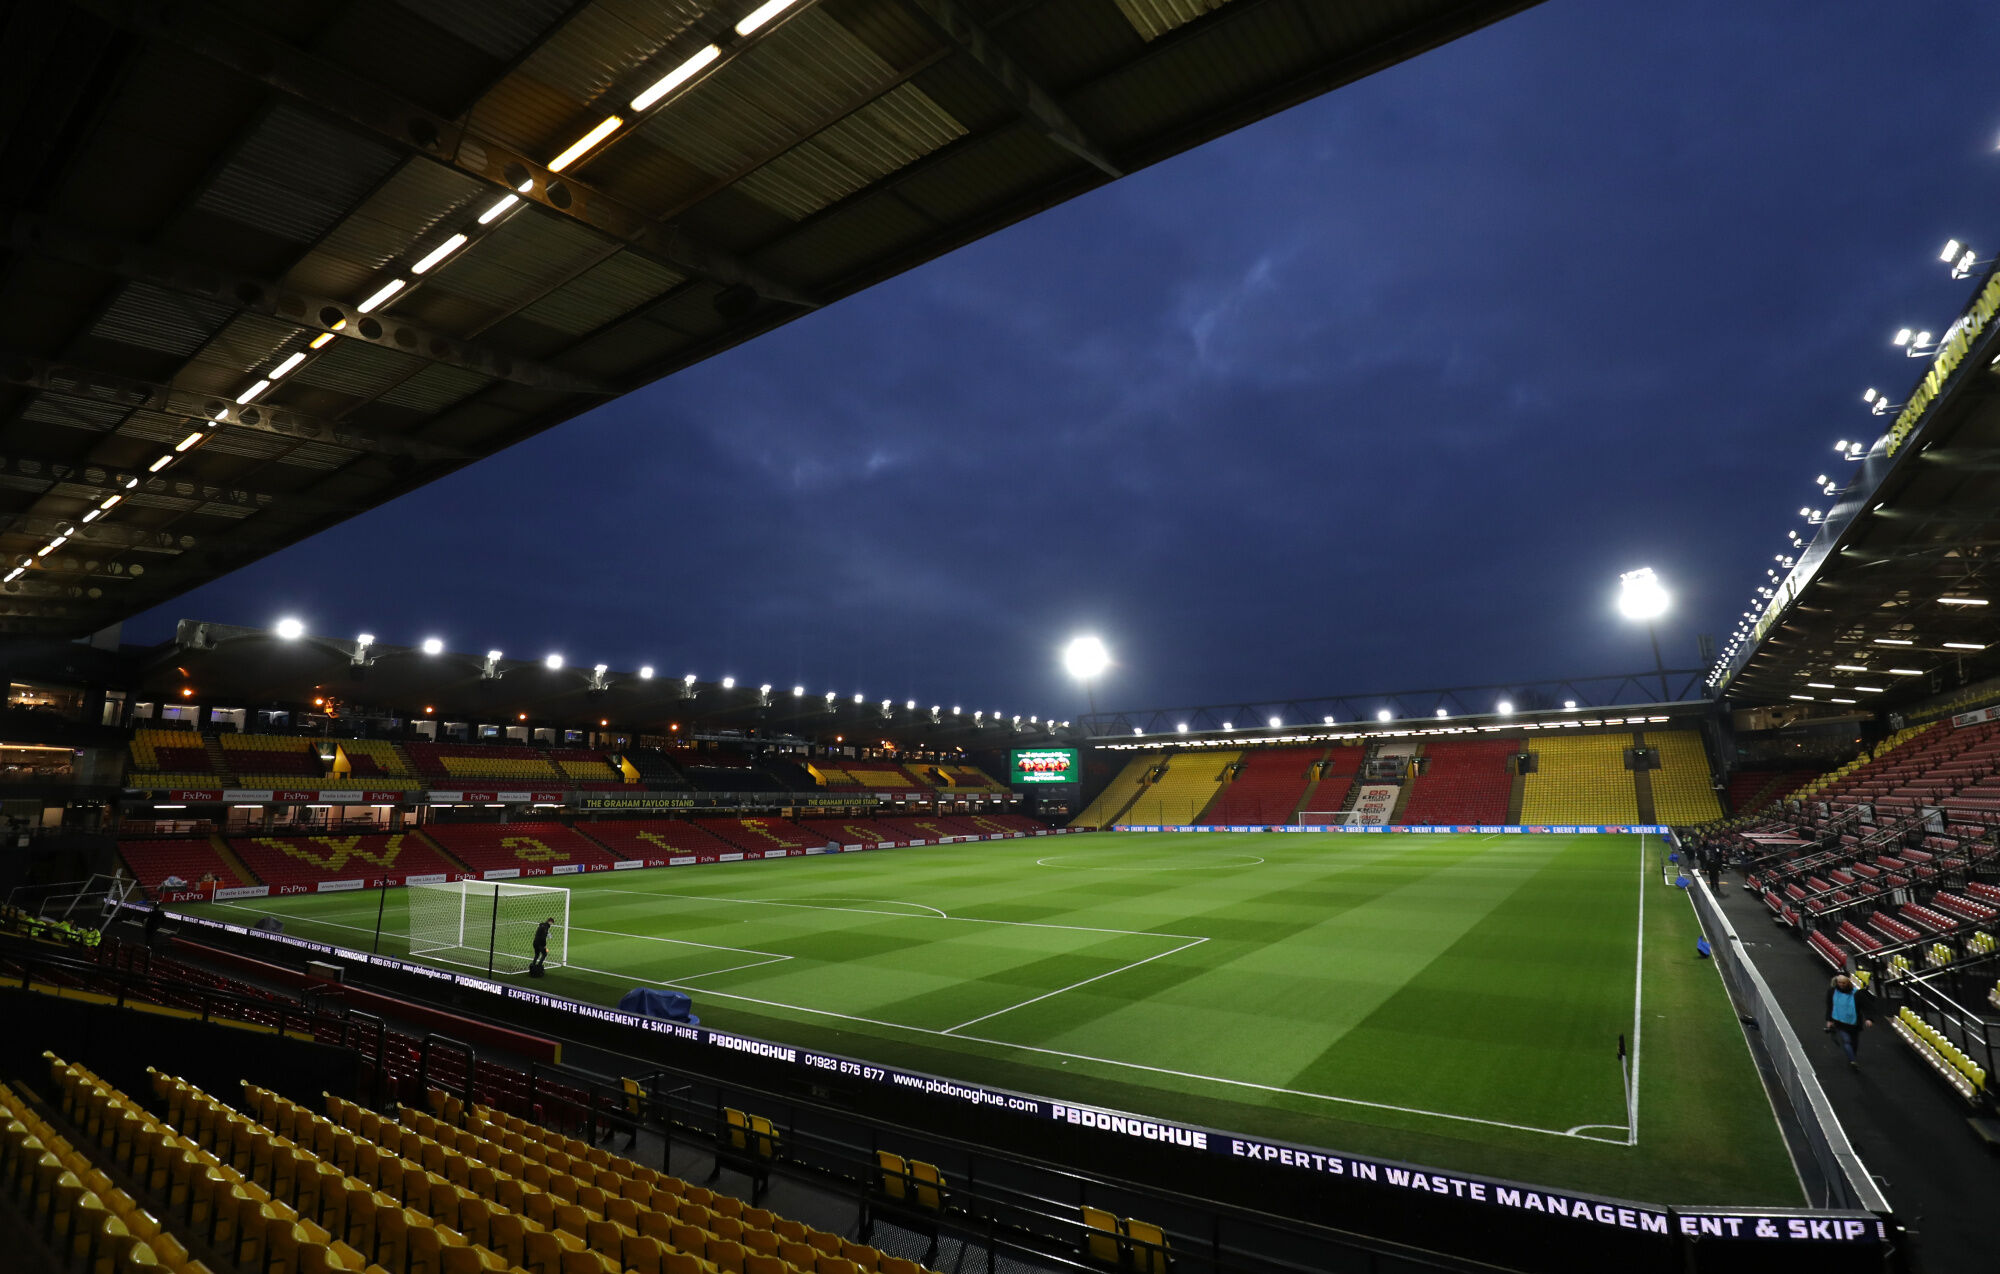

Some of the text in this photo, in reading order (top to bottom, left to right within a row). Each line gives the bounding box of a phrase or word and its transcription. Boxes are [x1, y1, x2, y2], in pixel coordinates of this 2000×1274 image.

[182, 791, 212, 800] FxPro
[284, 791, 309, 800] FxPro
[372, 792, 395, 800] FxPro
[587, 799, 695, 808] THE GRAHAM TAYLOR STAND
[1631, 826, 1656, 834] ENERGY
[527, 867, 546, 876] FxPro
[455, 873, 476, 882] FxPro
[280, 884, 307, 894] FxPro
[172, 892, 204, 901] FxPro
[402, 963, 452, 981] www.pbdonoghue.com
[454, 975, 699, 1041] PBDONOGHUE EXPERTS IN WASTE MANAGEMENT & SKIP HIRE
[708, 1032, 1039, 1114] PBDONOGHUE 01923 675 677 www.pbdonoghue.com
[1052, 1104, 1208, 1150] PBDONOGHUE
[1231, 1139, 1345, 1175] EXPERTS
[1351, 1160, 1378, 1182] IN
[1384, 1167, 1487, 1201] WASTE
[1754, 1217, 1780, 1239] &
[1787, 1217, 1866, 1241] SKIP
